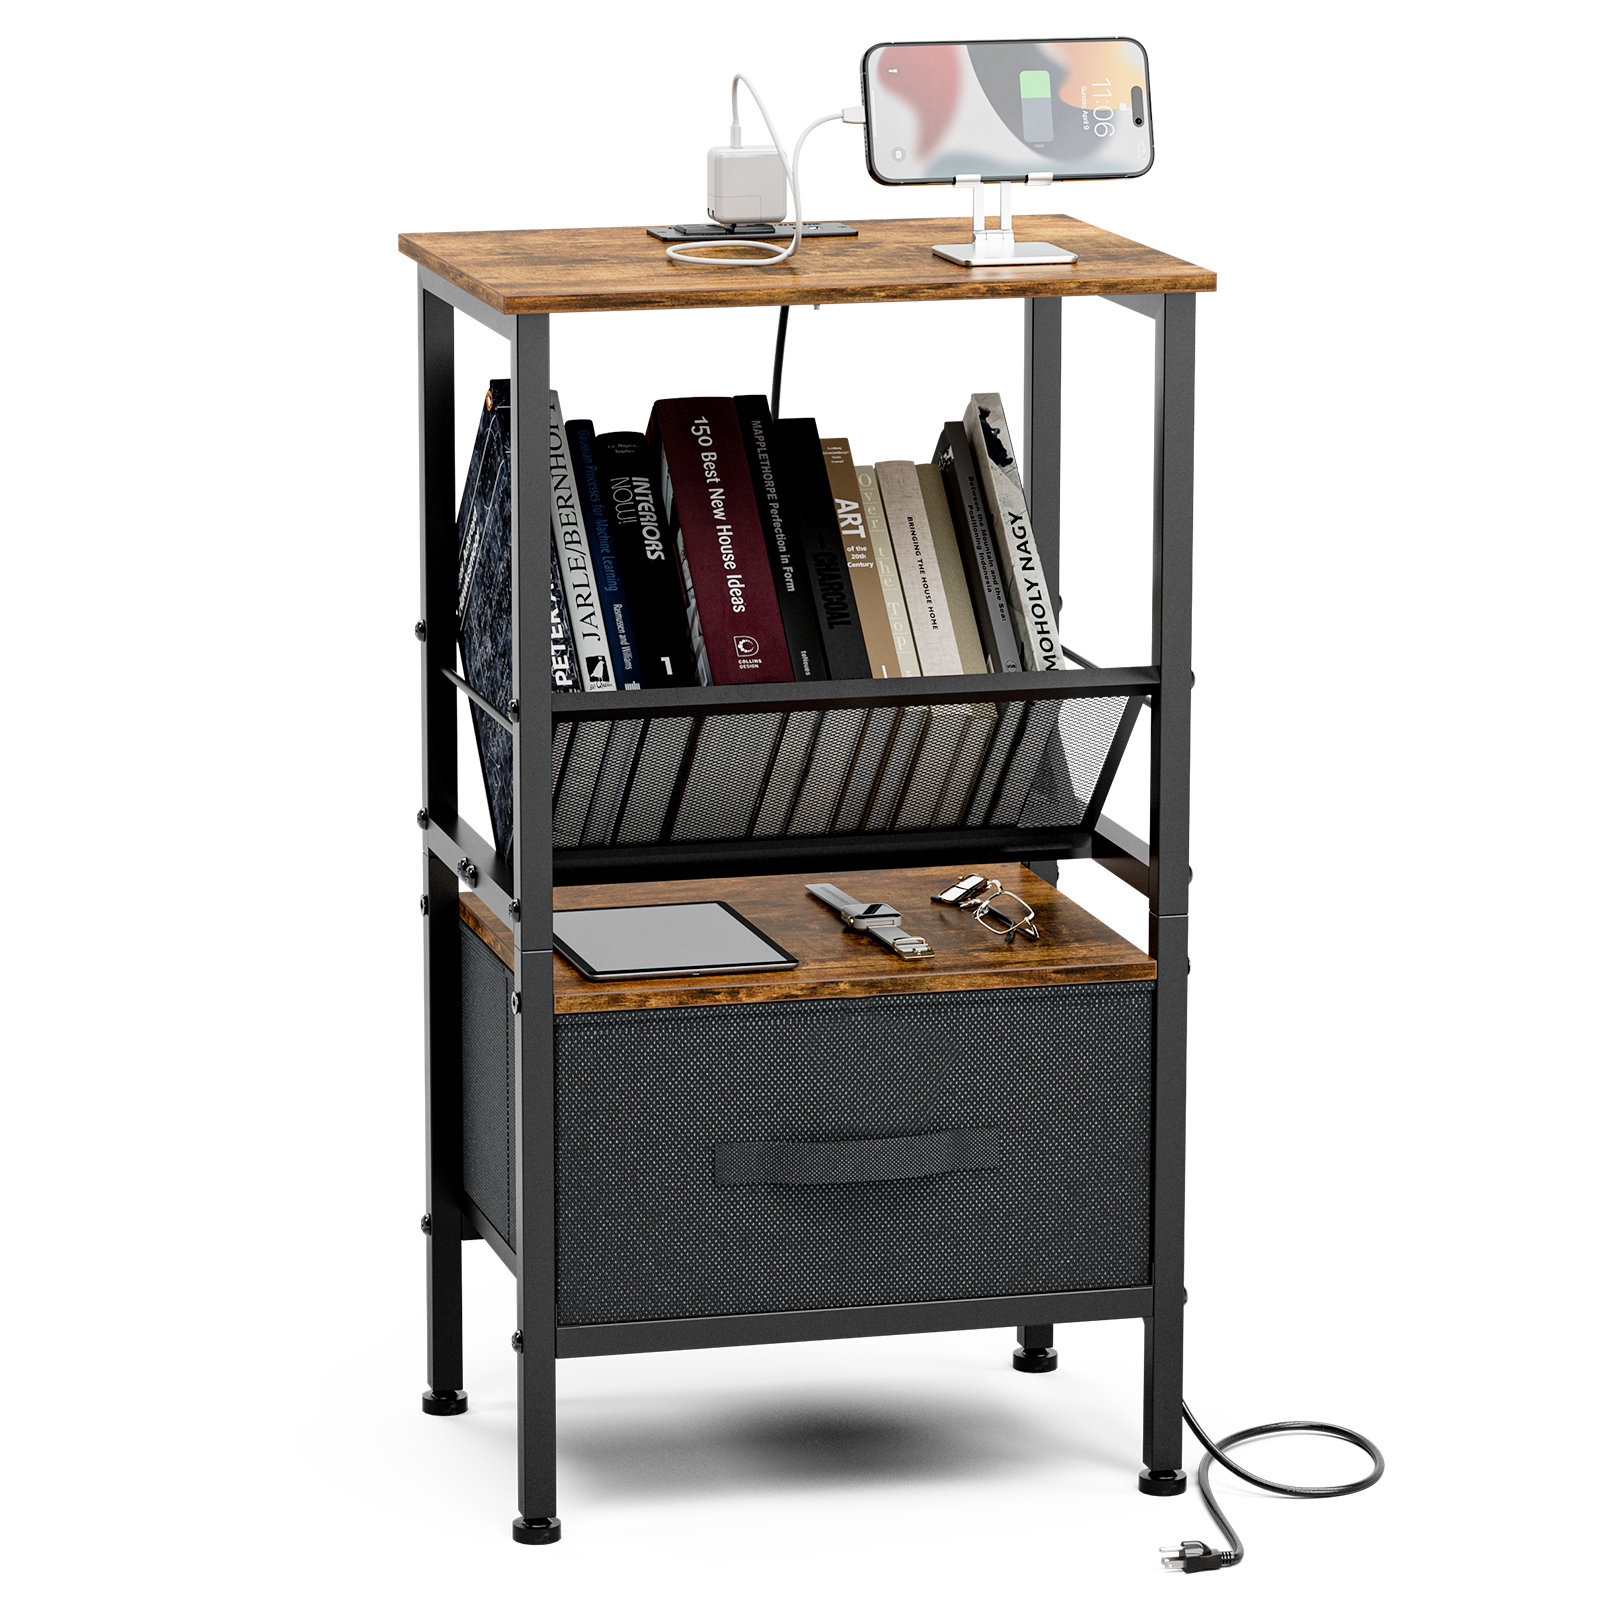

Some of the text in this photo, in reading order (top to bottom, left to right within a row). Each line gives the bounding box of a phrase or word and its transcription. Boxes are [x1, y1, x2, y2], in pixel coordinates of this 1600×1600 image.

[1092, 78, 1114, 137] 11:06
[584, 465, 601, 503] Processes
[610, 476, 638, 525] NOW!
[690, 416, 746, 613] 150 Best New House Ideas
[751, 420, 795, 592] MAPPLETHORPE Perfection in Form
[550, 403, 601, 641] JARLE/BERNHO
[597, 519, 610, 552] Machine
[632, 477, 665, 560] INTERIORS
[834, 498, 866, 538] ART
[854, 545, 867, 553] the
[968, 476, 981, 511] Between
[980, 529, 994, 566] Mountain
[990, 566, 998, 585] and
[968, 505, 992, 593] Positioning Indonesia
[602, 556, 620, 592] Learning
[851, 552, 866, 560] 20th
[907, 516, 938, 630] BRINGING THE HOUSE HOME
[1008, 511, 1059, 671] MOHOLY NAGY
[612, 603, 632, 669] Rasmussen and Williams
